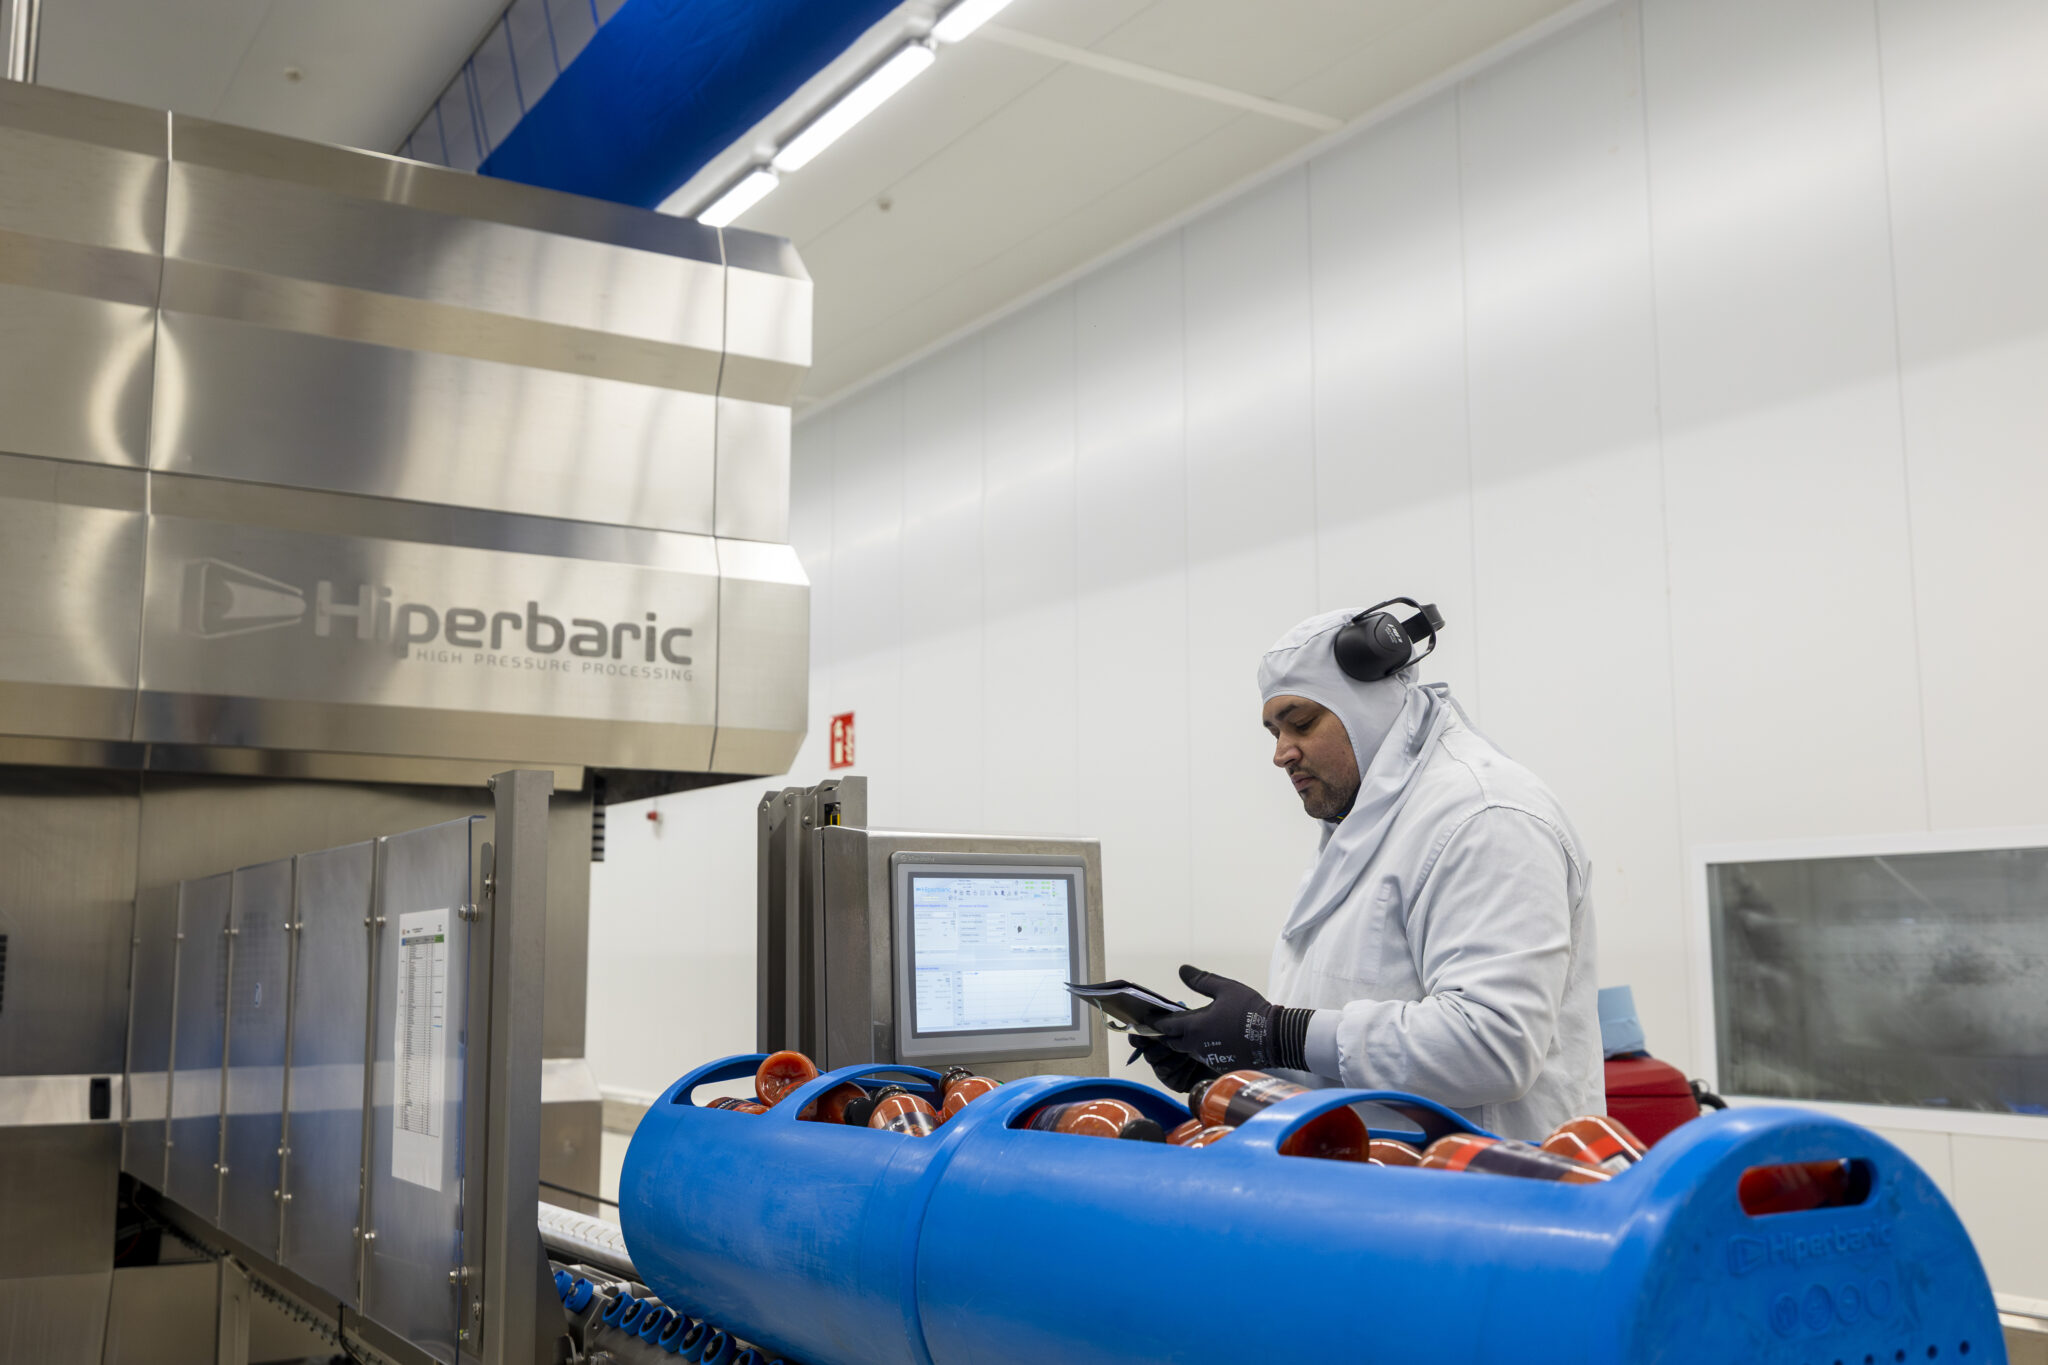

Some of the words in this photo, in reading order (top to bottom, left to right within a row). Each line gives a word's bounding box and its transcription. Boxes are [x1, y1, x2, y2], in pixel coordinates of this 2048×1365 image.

[316, 580, 693, 666] Hiperbaric
[416, 648, 463, 664] HIGH
[473, 653, 572, 673] PRESSURE
[582, 662, 693, 682] PROCESSING
[1768, 1220, 1894, 1269] Hiperbaric
